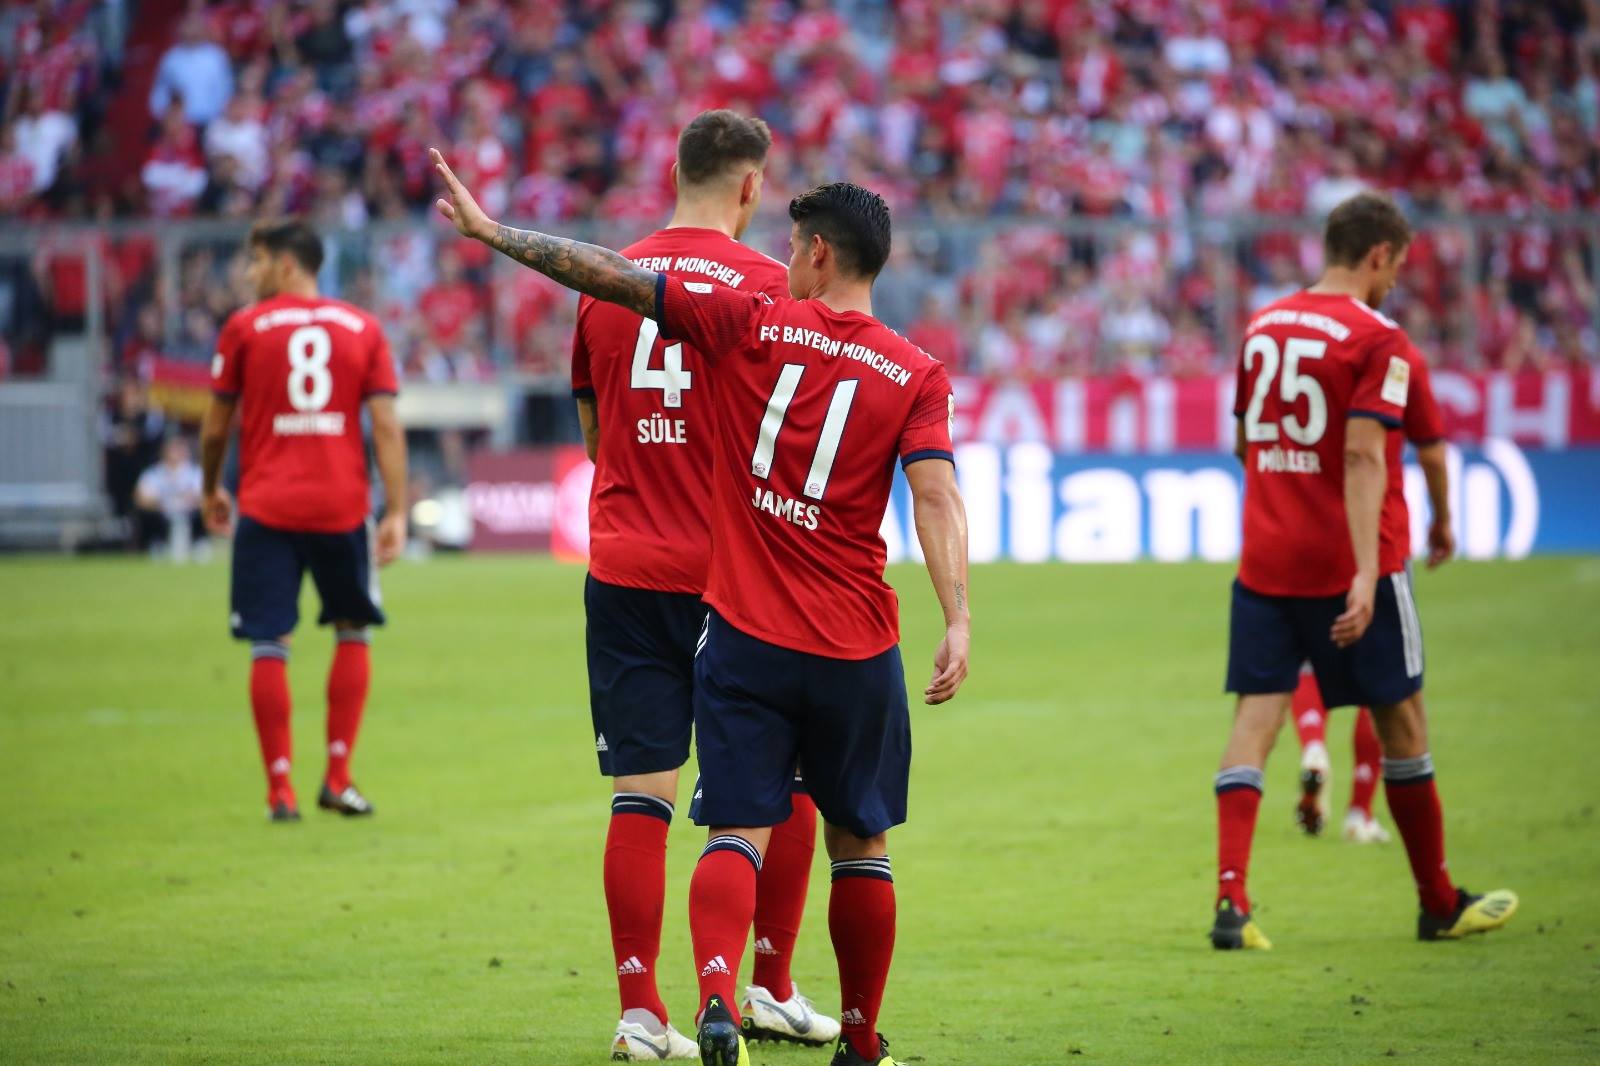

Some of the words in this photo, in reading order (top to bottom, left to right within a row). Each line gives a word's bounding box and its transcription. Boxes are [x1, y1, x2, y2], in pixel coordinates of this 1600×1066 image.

[628, 257, 672, 272] YERN
[630, 316, 692, 408] 4
[760, 325, 780, 342] FC
[782, 325, 842, 357] BAYERN
[288, 325, 333, 413] 8
[1244, 333, 1328, 446] 25
[636, 413, 687, 444] SÜLE
[751, 362, 859, 501] 11
[751, 486, 821, 531] JAMES
[701, 965, 731, 977] adidas
